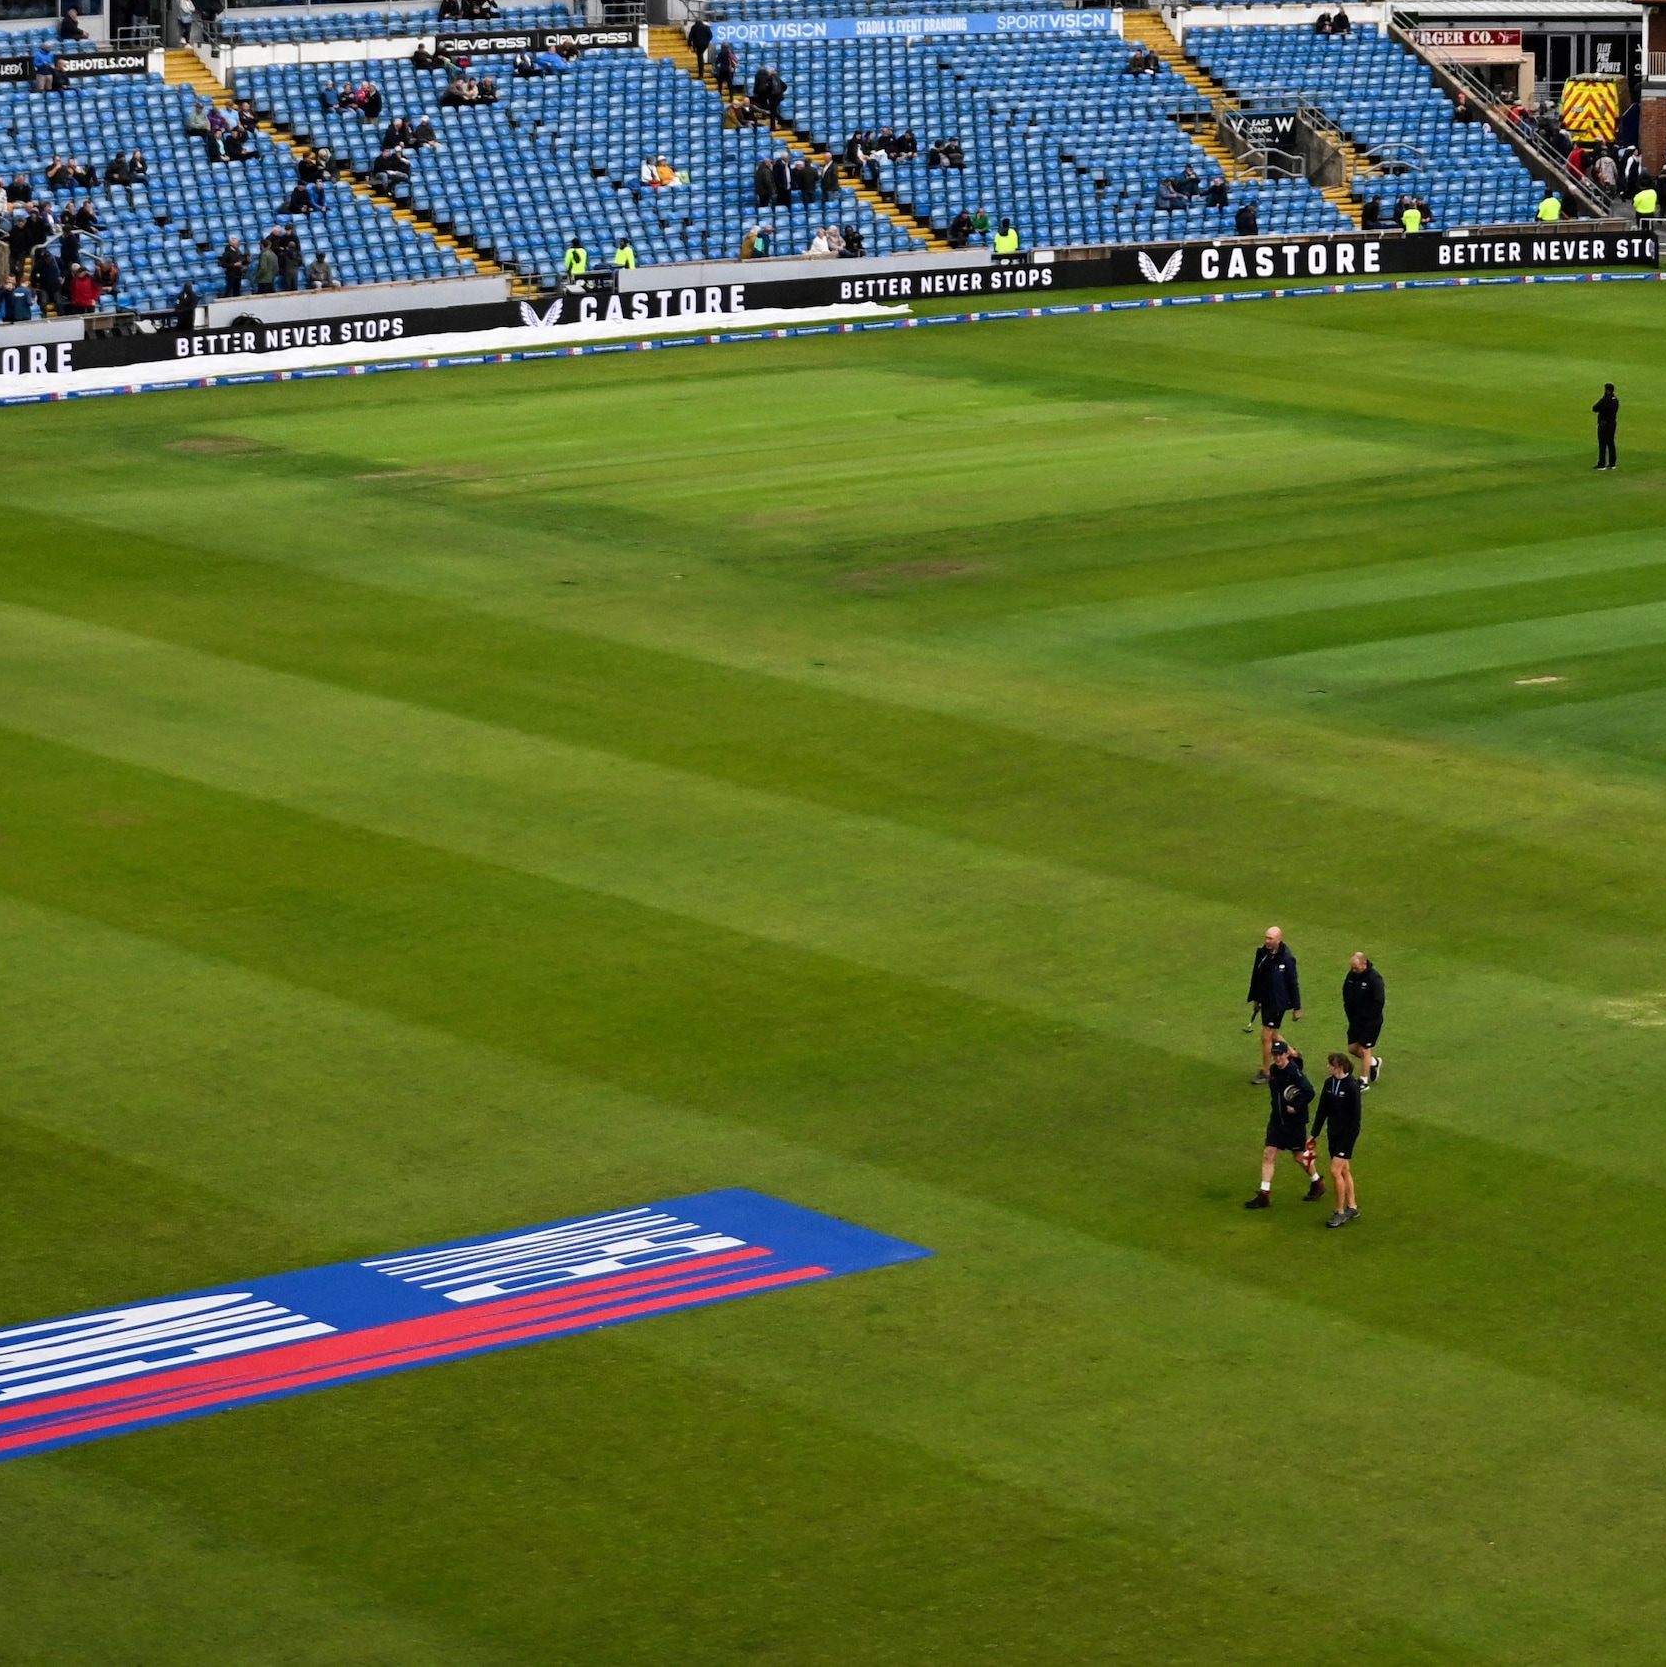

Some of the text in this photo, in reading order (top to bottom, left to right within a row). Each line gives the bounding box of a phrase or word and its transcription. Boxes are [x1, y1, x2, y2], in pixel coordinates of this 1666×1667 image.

[856, 17, 967, 35] STADIA & EVENT BRANDING
[997, 13, 1105, 30] SPORT VISION
[717, 22, 827, 40] SPORT VISION
[1469, 30, 1495, 45] CO.
[1, 62, 24, 76] LEEDS
[1251, 118, 1270, 126] EAST
[1275, 116, 1295, 132] W
[1200, 242, 1381, 280] CASTORE
[1439, 242, 1521, 266] BETTER
[1533, 240, 1605, 263] NEVER
[841, 268, 1053, 300] BETTER NEVER STOPS
[579, 284, 746, 324] CASTORE
[176, 317, 405, 358] BETTER NEVER STOPS
